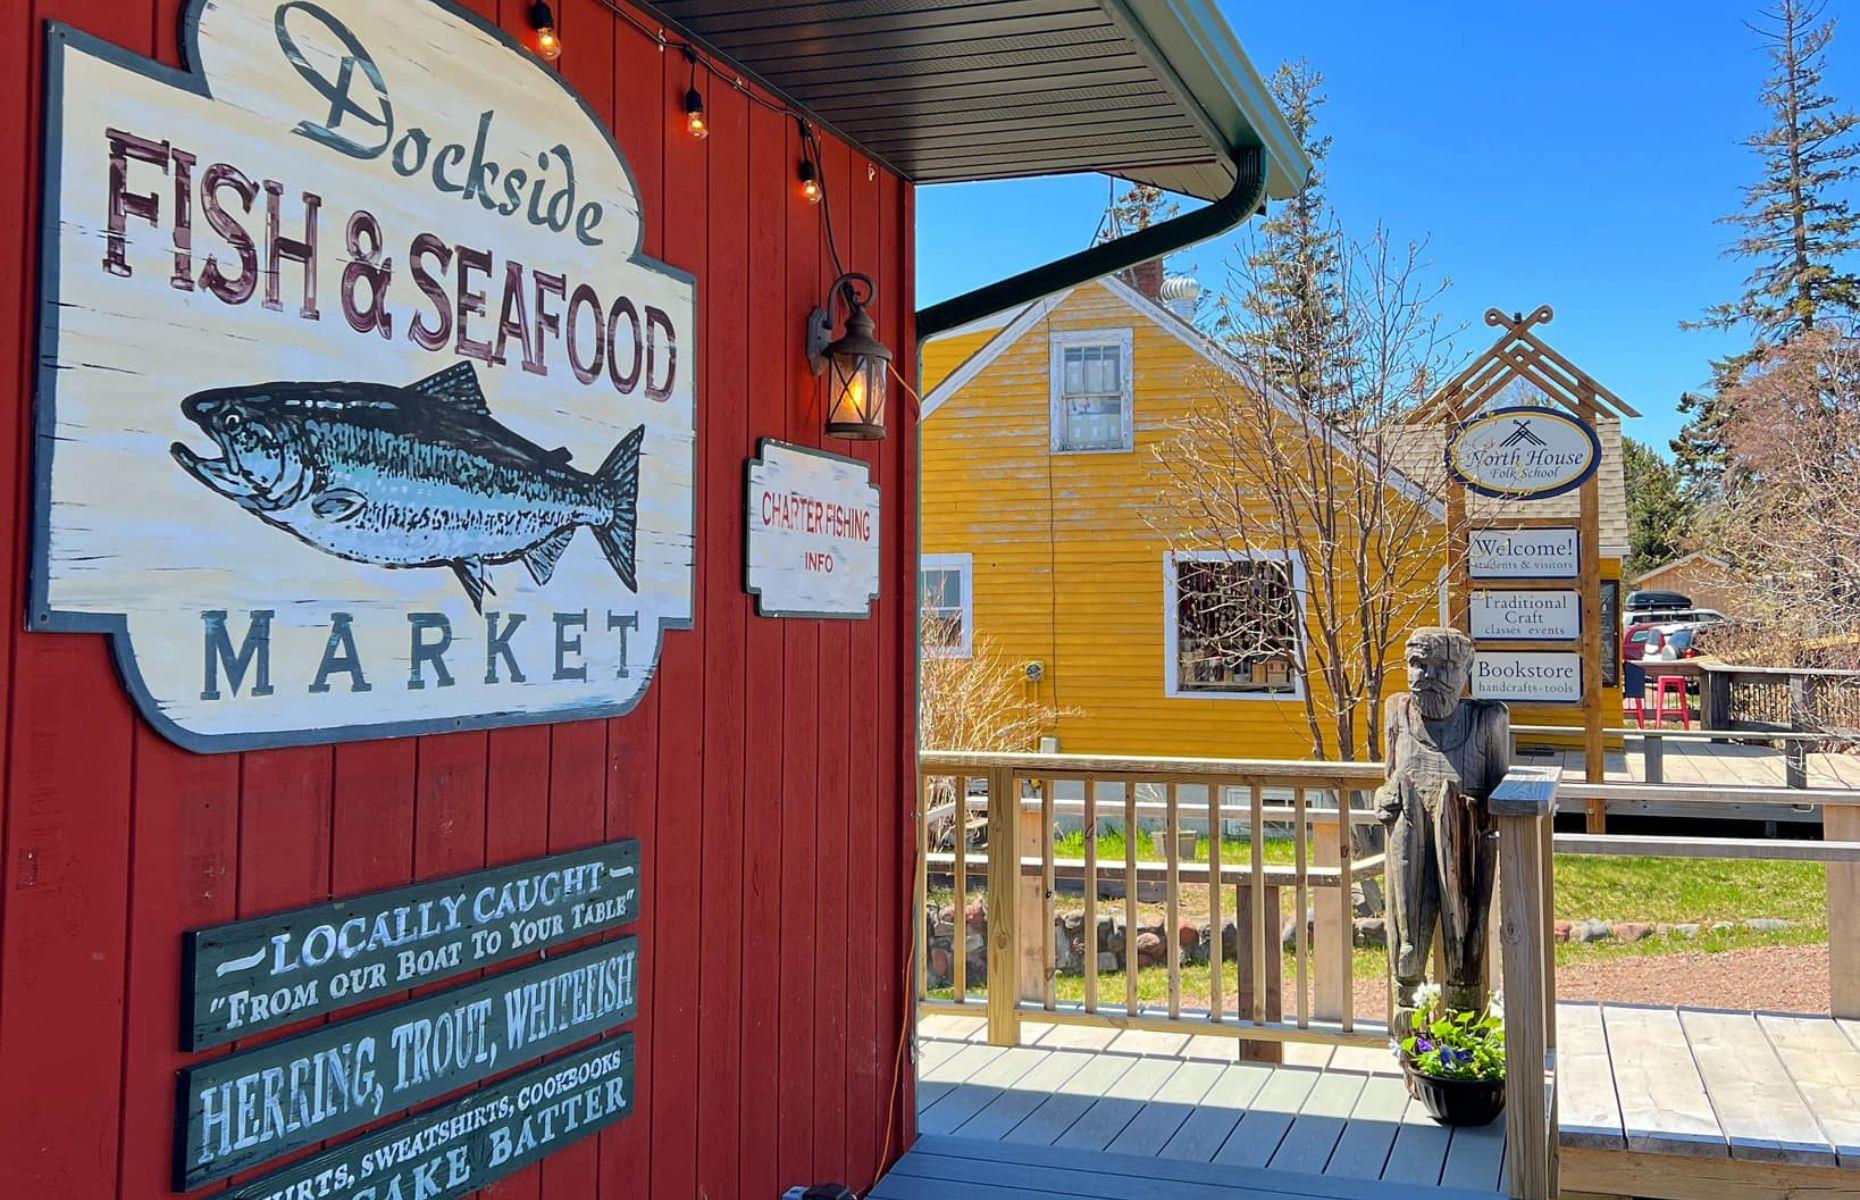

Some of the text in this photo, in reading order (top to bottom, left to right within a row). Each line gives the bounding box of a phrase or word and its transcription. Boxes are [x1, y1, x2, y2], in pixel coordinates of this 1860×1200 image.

[273, 1, 604, 246] Dockside
[101, 127, 676, 400] FISH & SEAFOOD
[1466, 448, 1584, 467] North House
[1491, 466, 1560, 479] Folk School
[762, 491, 870, 541] CHARTER FISHING
[1475, 538, 1573, 556] Welcome!
[804, 551, 833, 573] INFO
[1521, 561, 1530, 569] &
[1534, 560, 1573, 569] visitors
[1484, 595, 1568, 609] Traditional
[1505, 610, 1543, 624] Craft
[1484, 624, 1565, 635] classes events
[200, 609, 640, 700] MARKET
[1478, 660, 1573, 678] Bookstore
[1478, 681, 1574, 693] handcrafts tools
[269, 862, 604, 976] LOCALLY CAUGHT
[329, 963, 387, 999] OUR
[397, 942, 462, 981] BOAT
[471, 930, 502, 959] TO
[509, 915, 563, 949] YOUR
[199, 950, 636, 1165] HERRING, TROUT, WHITEFISH
[361, 1095, 516, 1179] SWEATSHIRTS,
[517, 1048, 621, 1112] COOKBOOKS
[488, 1075, 627, 1169] BATTER
